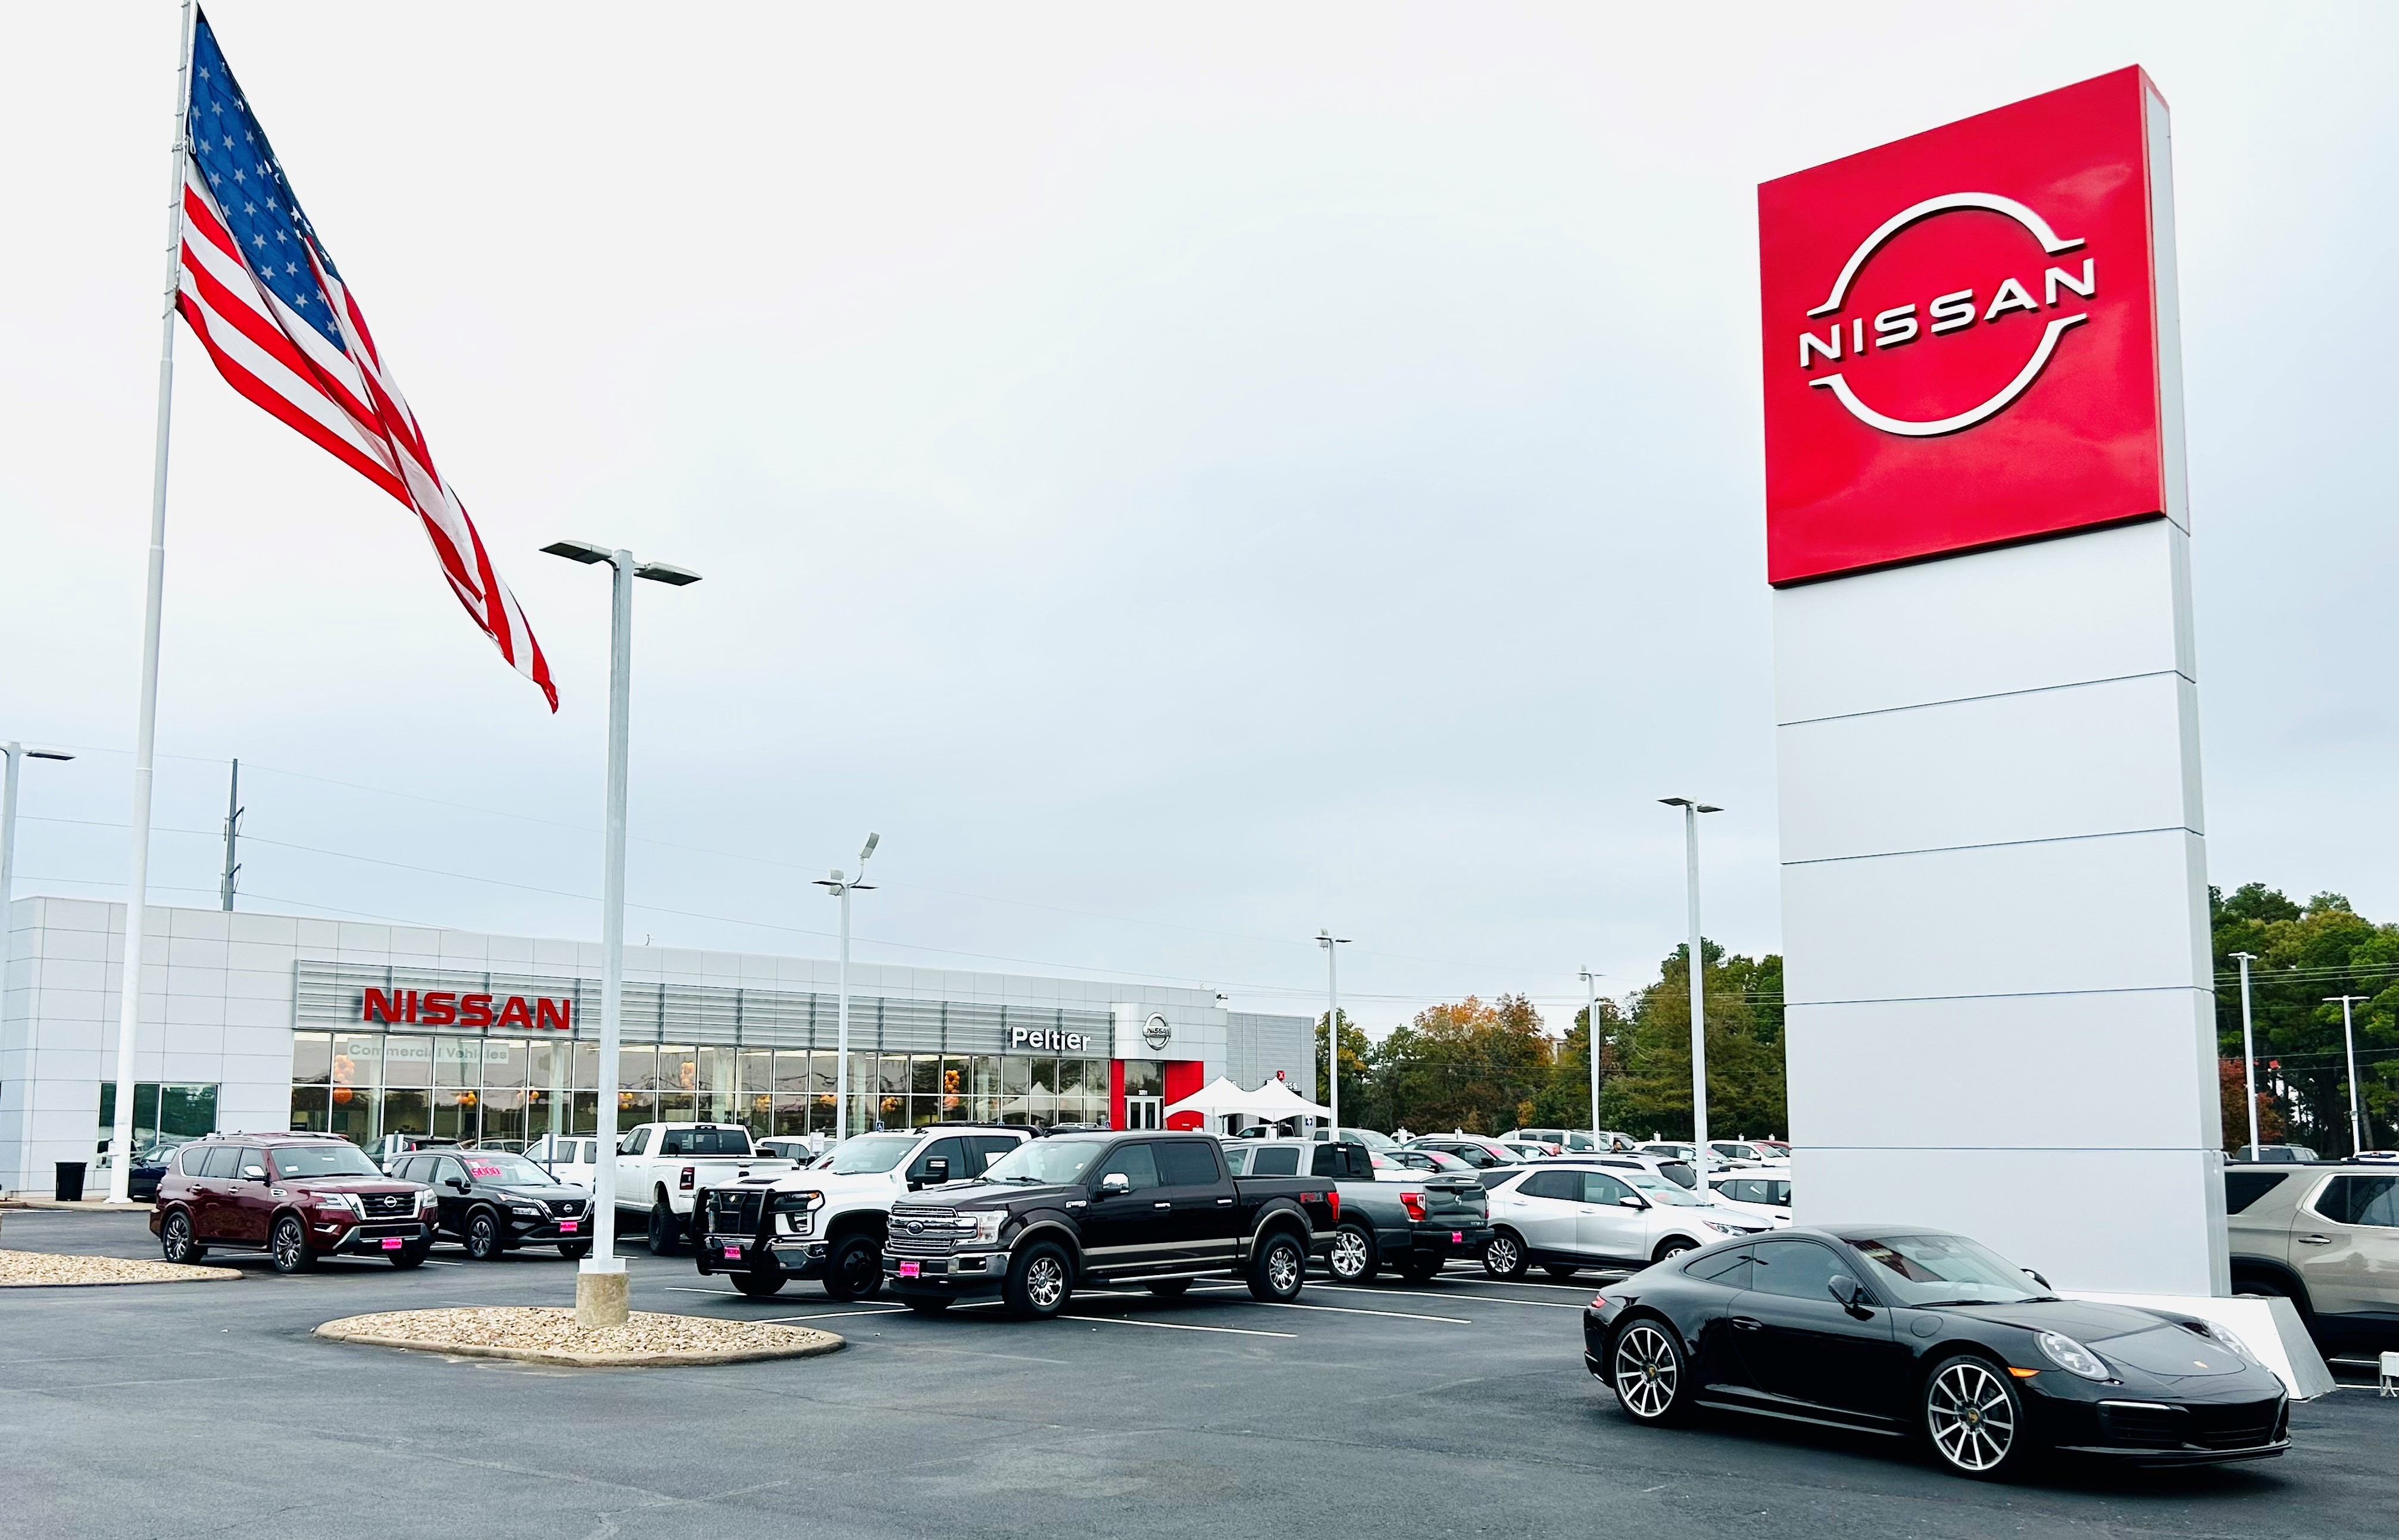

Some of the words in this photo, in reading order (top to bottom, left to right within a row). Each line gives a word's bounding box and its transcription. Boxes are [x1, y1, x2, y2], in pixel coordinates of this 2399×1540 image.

[1799, 258, 2095, 367] NISSAN
[363, 988, 570, 1029] NISSAN
[446, 1047, 507, 1060] Vehiles
[1011, 1026, 1091, 1052] Peltier
